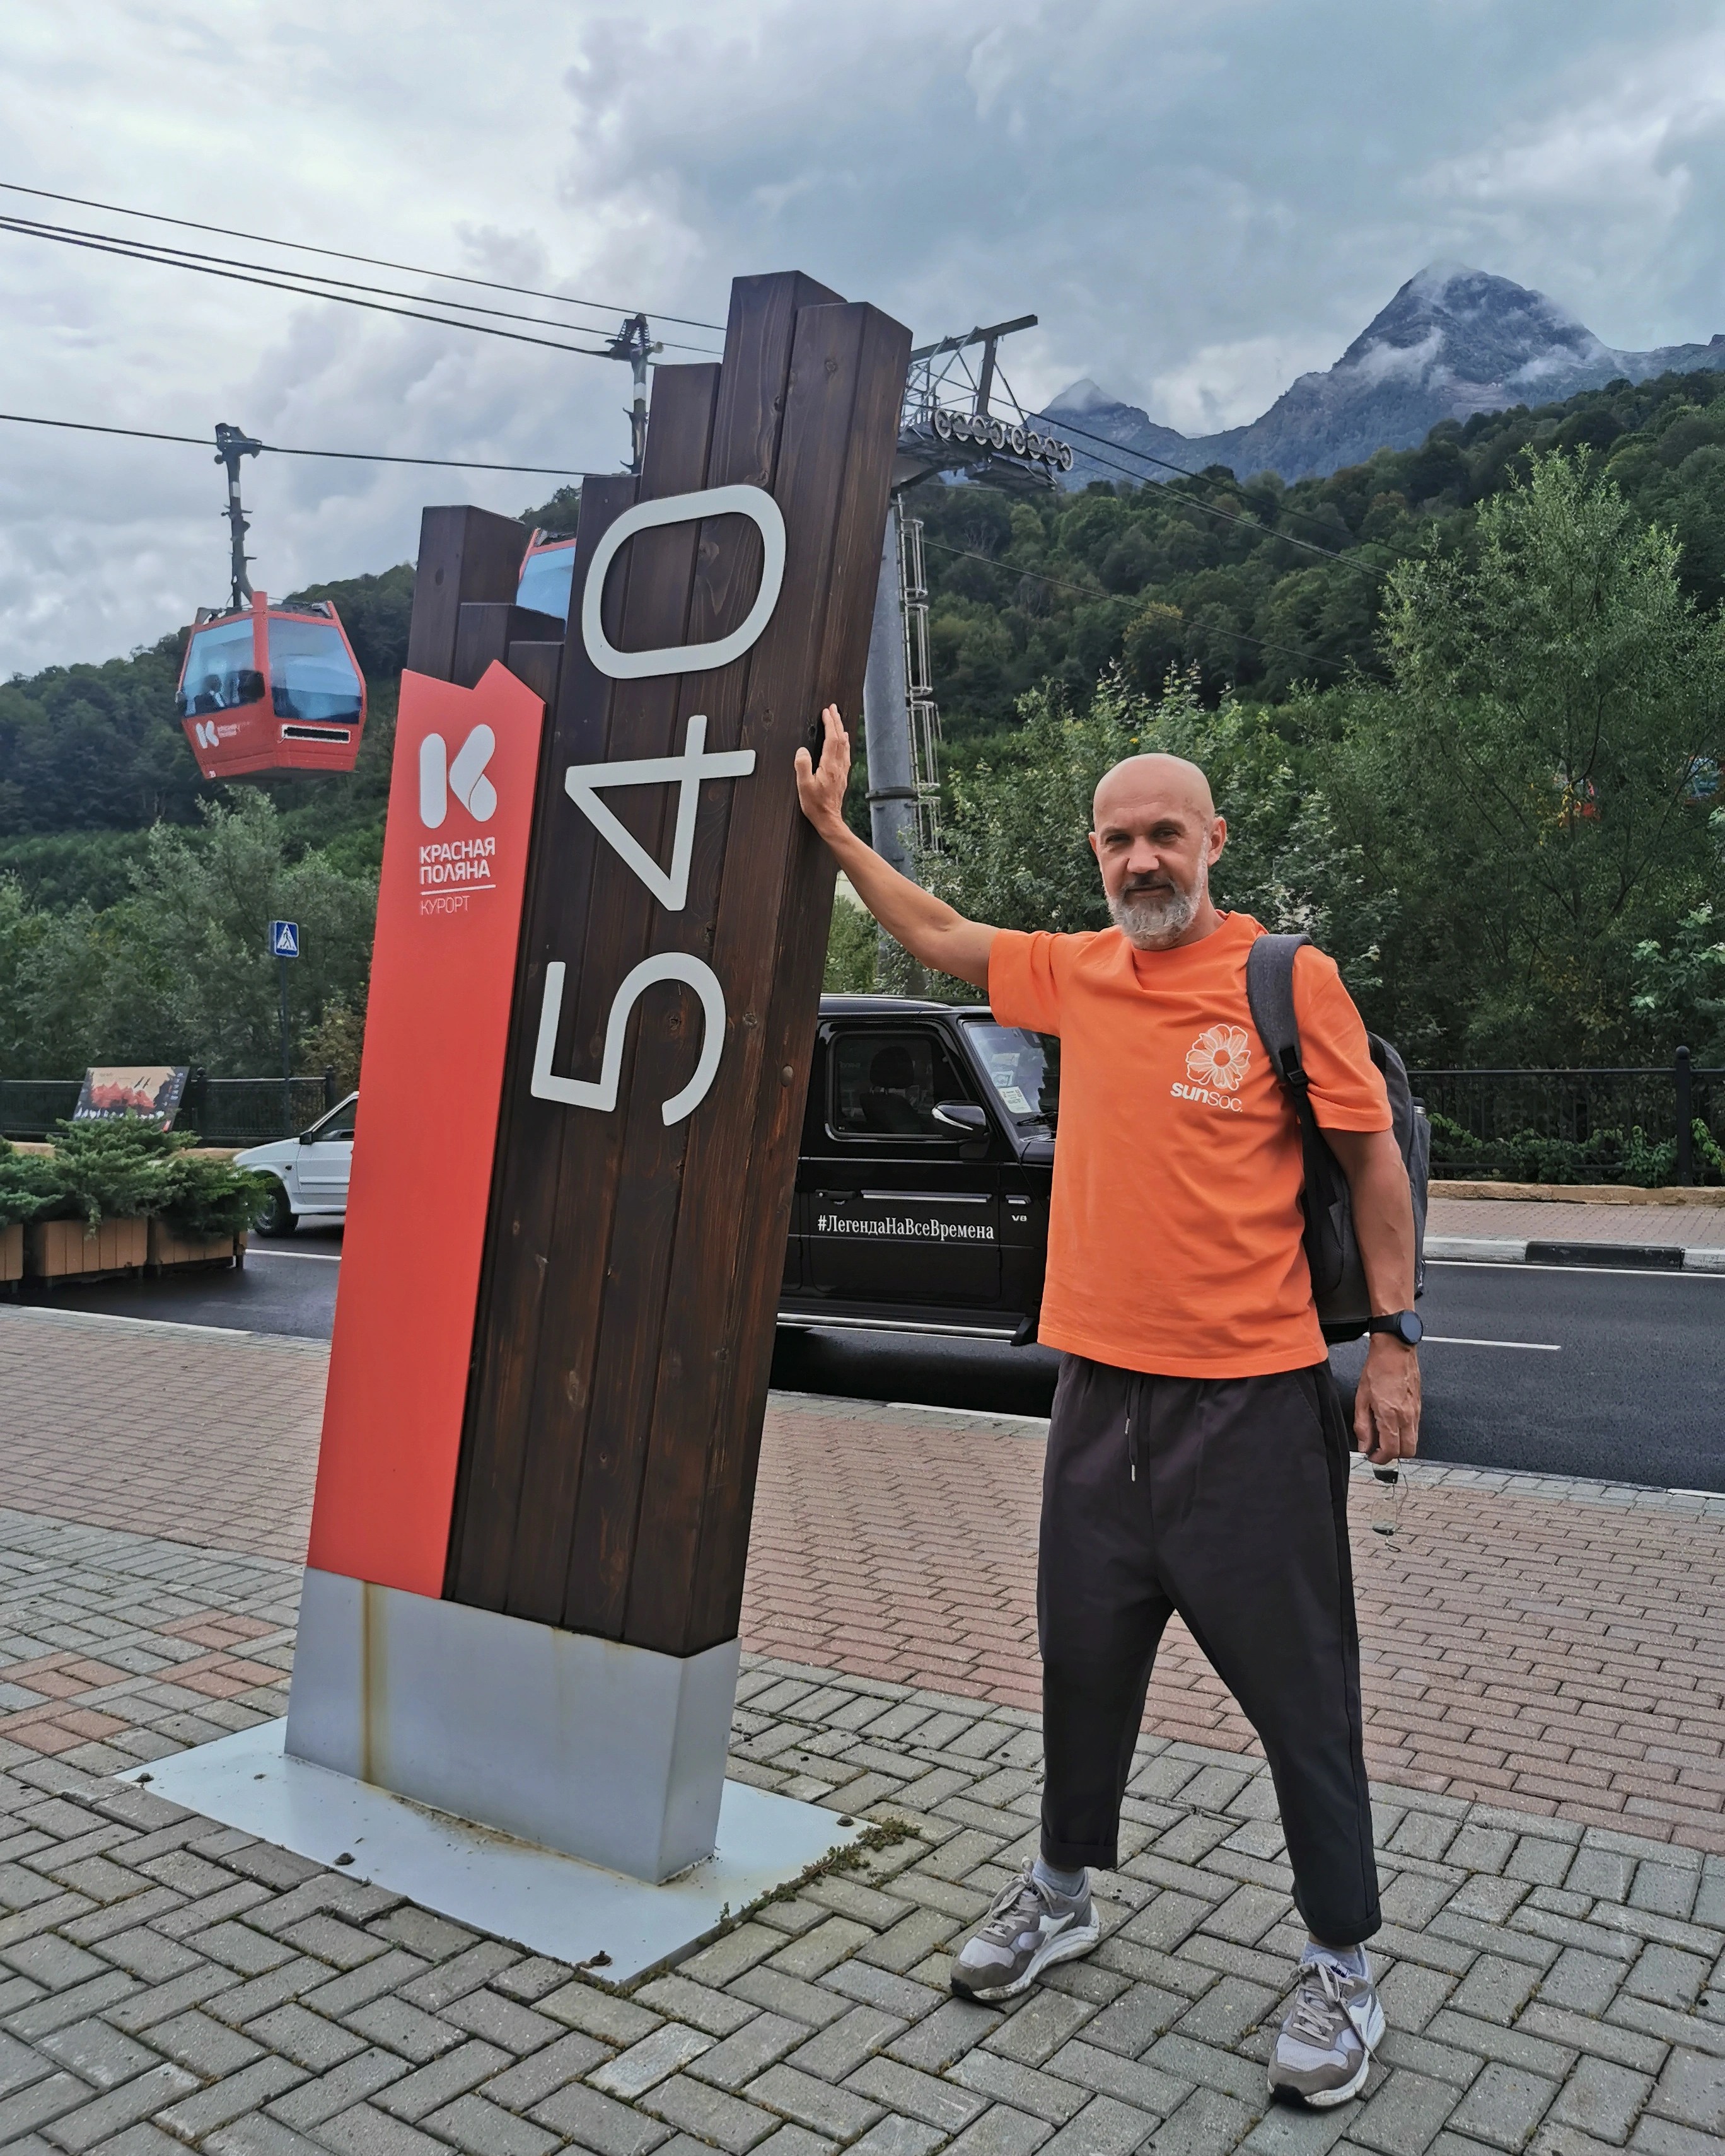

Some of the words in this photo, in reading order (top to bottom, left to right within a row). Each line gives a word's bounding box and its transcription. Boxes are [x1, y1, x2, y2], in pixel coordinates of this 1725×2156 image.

[530, 484, 786, 1126] 540
[419, 837, 496, 864] КРАСНАЯ
[420, 859, 491, 885] ПОЛЯНА
[421, 895, 471, 915] КУРОРТ
[817, 1214, 994, 1241] #ЛегендаНаВсеВремена
